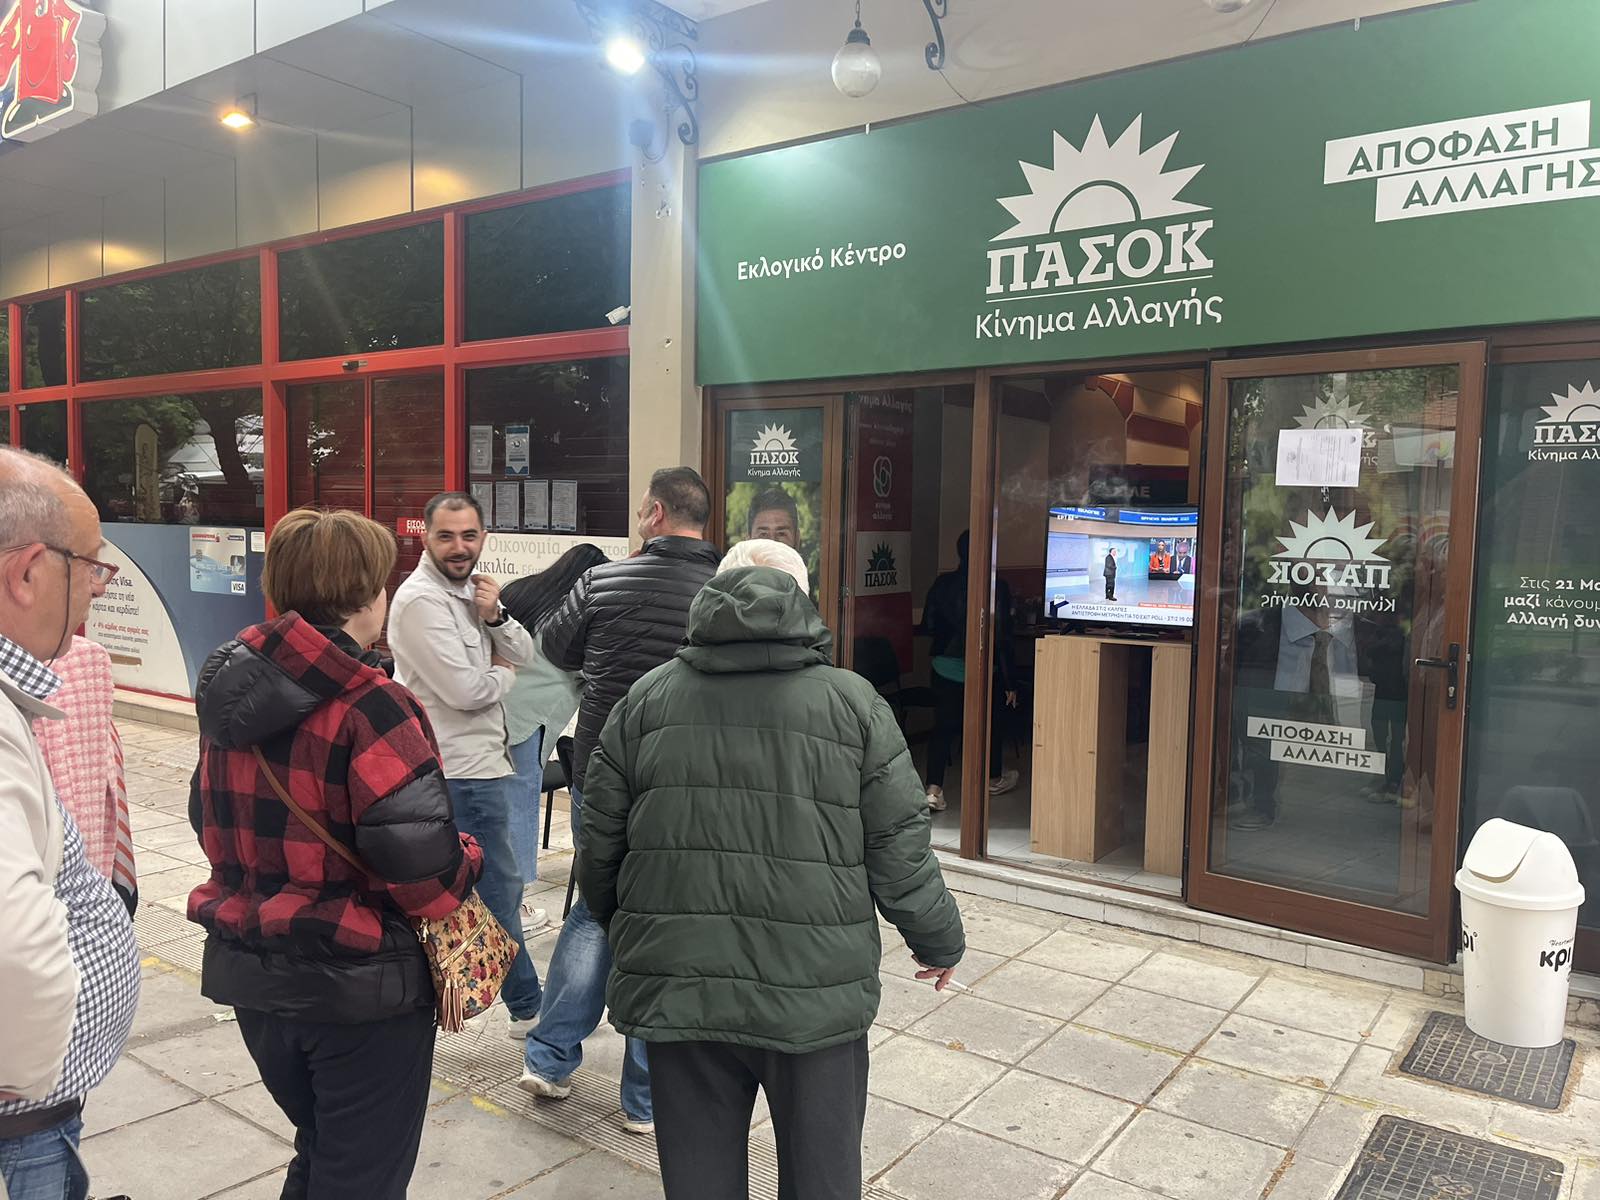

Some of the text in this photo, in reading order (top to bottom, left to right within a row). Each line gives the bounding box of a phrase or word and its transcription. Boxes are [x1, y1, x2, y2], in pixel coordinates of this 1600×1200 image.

[1347, 117, 1559, 175] ΑΠΟΦΑΣΗ
[1402, 157, 1600, 209] ΑΛΛΑΓΗΣ
[737, 241, 907, 281] Εκλογικό Κέντρο
[986, 219, 1214, 295] ΠΑΣΟΚ
[976, 288, 1224, 339] Κίνημα Αλλαγής
[750, 451, 799, 465] ΠΑΣΟΚ
[1528, 449, 1577, 462] Κίνημα
[747, 466, 801, 477] Κίνημα Αλλαγής
[488, 535, 566, 559] Οικονομία.
[233, 583, 244, 591] VISA
[864, 571, 897, 587] ΠΑΣΟΚ
[1520, 577, 1550, 591] Στις
[1555, 580, 1574, 590] 21
[1504, 593, 1540, 609] μαζί
[1507, 612, 1568, 629] Αλλαγή
[1258, 722, 1352, 745] ΑΠΟΦΑΣΗ
[1282, 745, 1371, 768] ΑΛΛΑΓΗΣ
